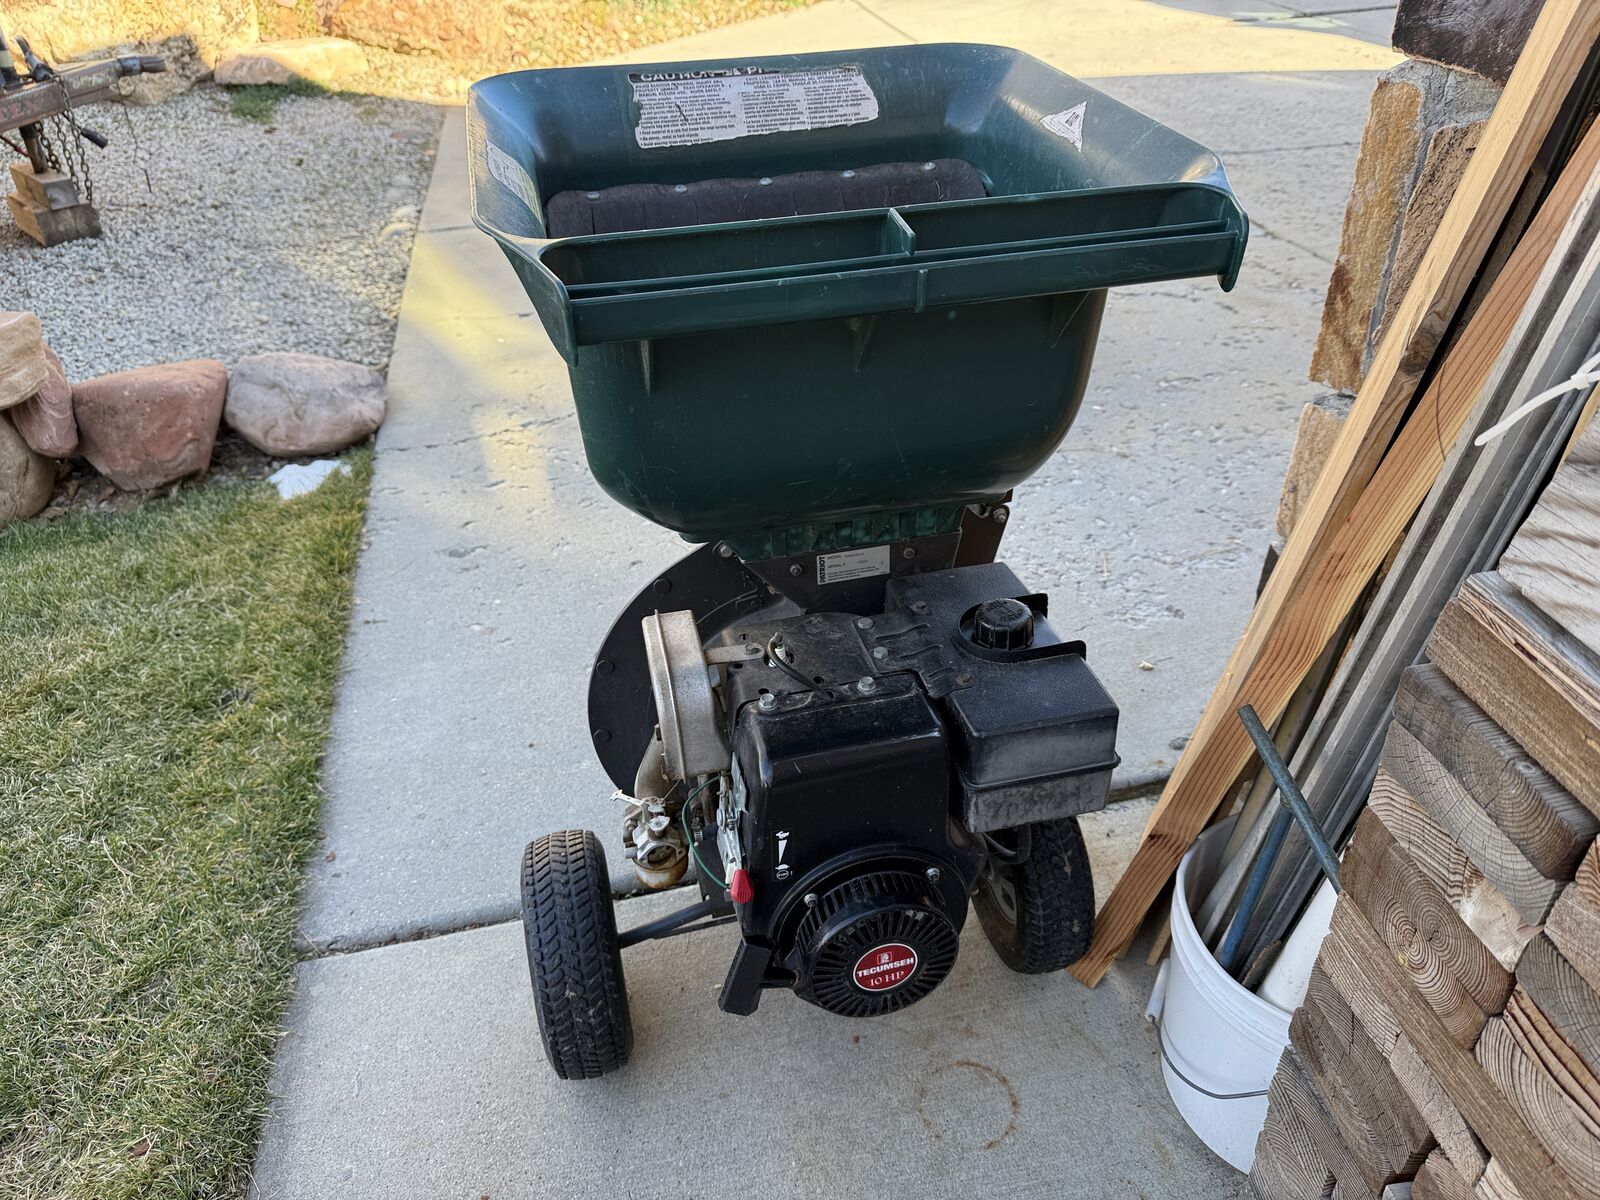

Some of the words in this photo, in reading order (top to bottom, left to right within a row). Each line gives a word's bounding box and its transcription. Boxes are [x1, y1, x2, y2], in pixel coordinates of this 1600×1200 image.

[818, 556, 826, 584] PATRIOT
[856, 957, 914, 978] TECUMSEH
[884, 970, 905, 983] HP
